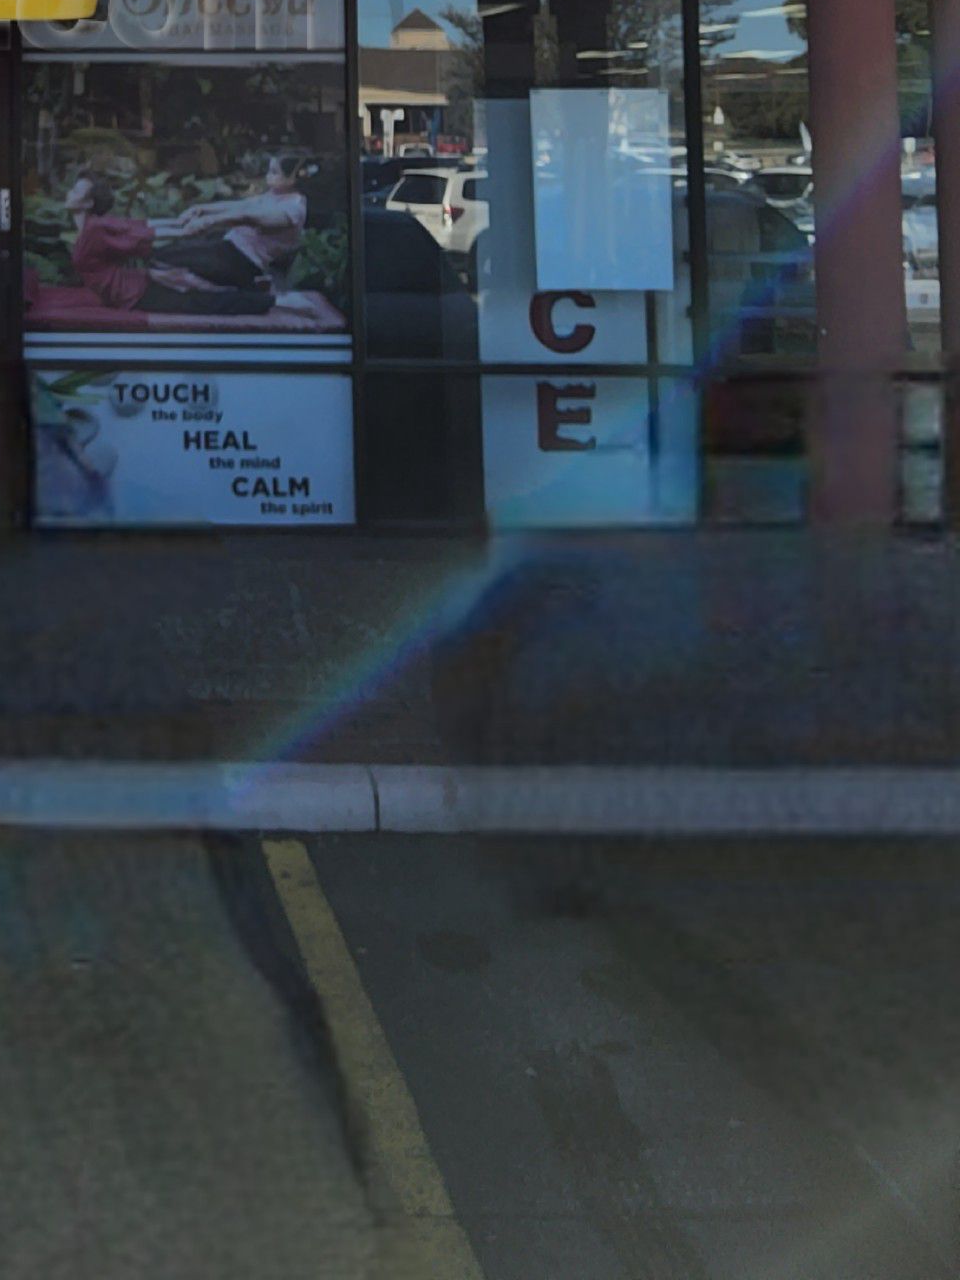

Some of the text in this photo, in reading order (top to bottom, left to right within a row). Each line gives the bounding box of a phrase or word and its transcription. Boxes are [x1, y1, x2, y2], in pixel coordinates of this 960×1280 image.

[115, 383, 210, 403] TOUCH
[152, 409, 223, 424] the body
[183, 430, 257, 450] HEAL
[209, 457, 281, 469] the mind
[231, 476, 310, 497] CALM
[261, 502, 333, 516] the spirit
